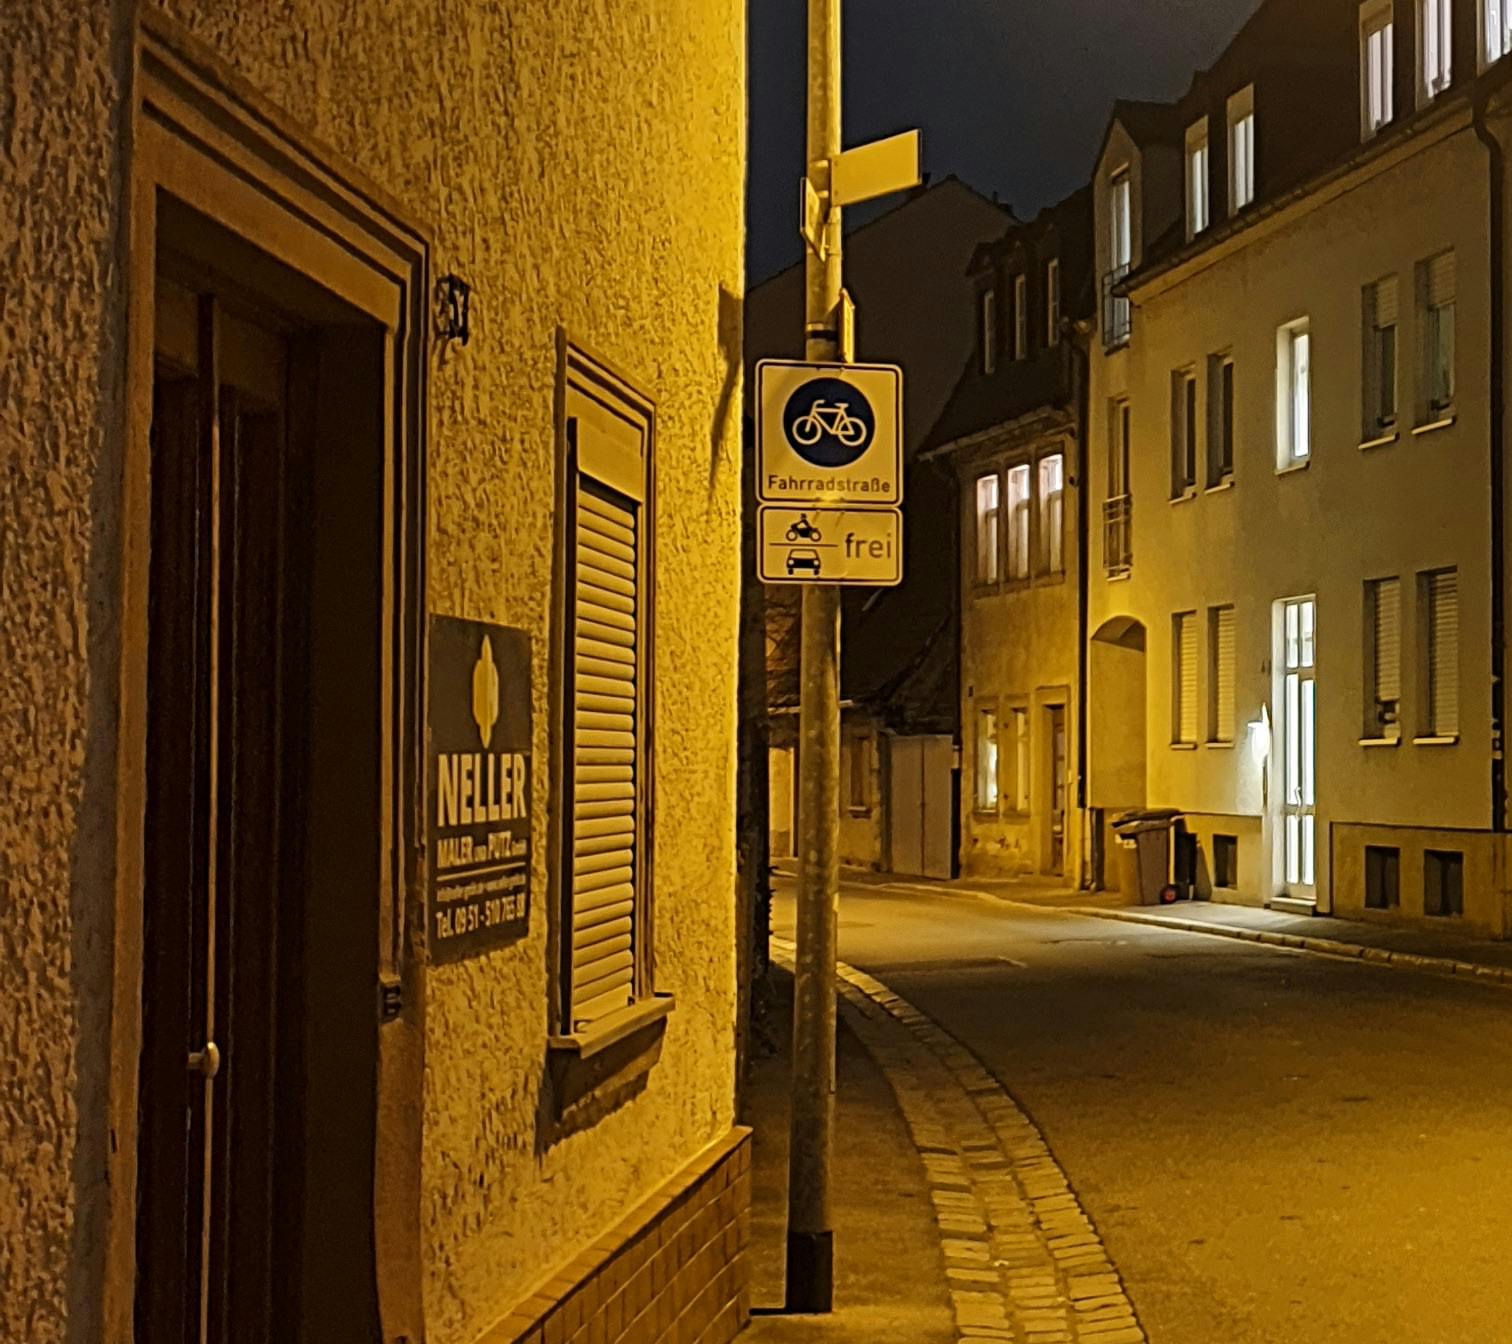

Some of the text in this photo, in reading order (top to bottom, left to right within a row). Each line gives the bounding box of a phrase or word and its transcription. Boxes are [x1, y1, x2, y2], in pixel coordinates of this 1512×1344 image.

[767, 474, 891, 493] Fahrradstraße
[845, 532, 892, 559] frei
[437, 753, 527, 827] NELLER
